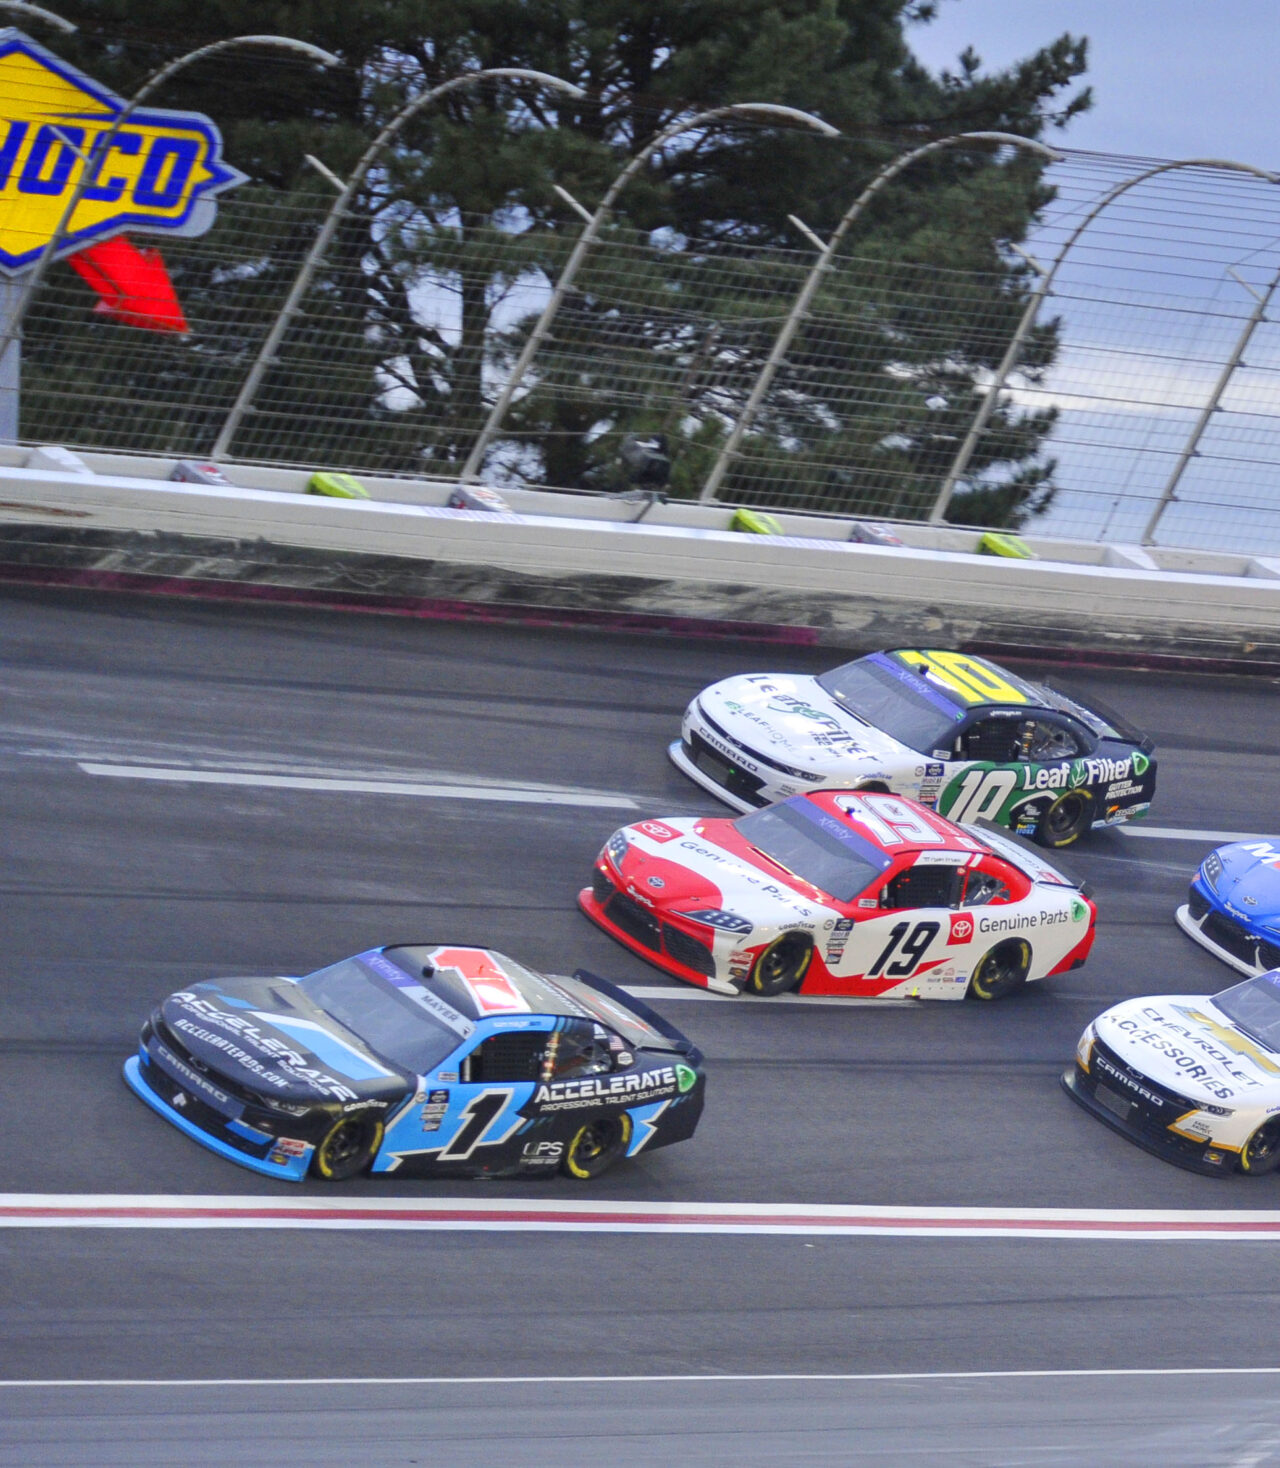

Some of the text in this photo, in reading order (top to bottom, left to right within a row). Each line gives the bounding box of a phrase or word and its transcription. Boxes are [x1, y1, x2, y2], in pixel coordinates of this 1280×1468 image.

[898, 650, 1028, 703] 10
[699, 727, 758, 772] CAMARO
[1022, 755, 1132, 791] Leaf Filter
[947, 770, 1017, 824] 10
[979, 909, 1069, 933] Genuine Parts
[866, 920, 941, 977] 19
[427, 947, 532, 1018] 1
[419, 993, 459, 1025] MAYER
[171, 991, 360, 1102] ACCELERATE
[157, 1045, 230, 1104] CAMARO
[535, 1065, 678, 1105] ACCELERATE
[539, 1084, 677, 1113] PROFESSIONAL TALENT SOLUTIONS
[1096, 1056, 1164, 1107] CAMARO
[437, 1087, 516, 1161] 1
